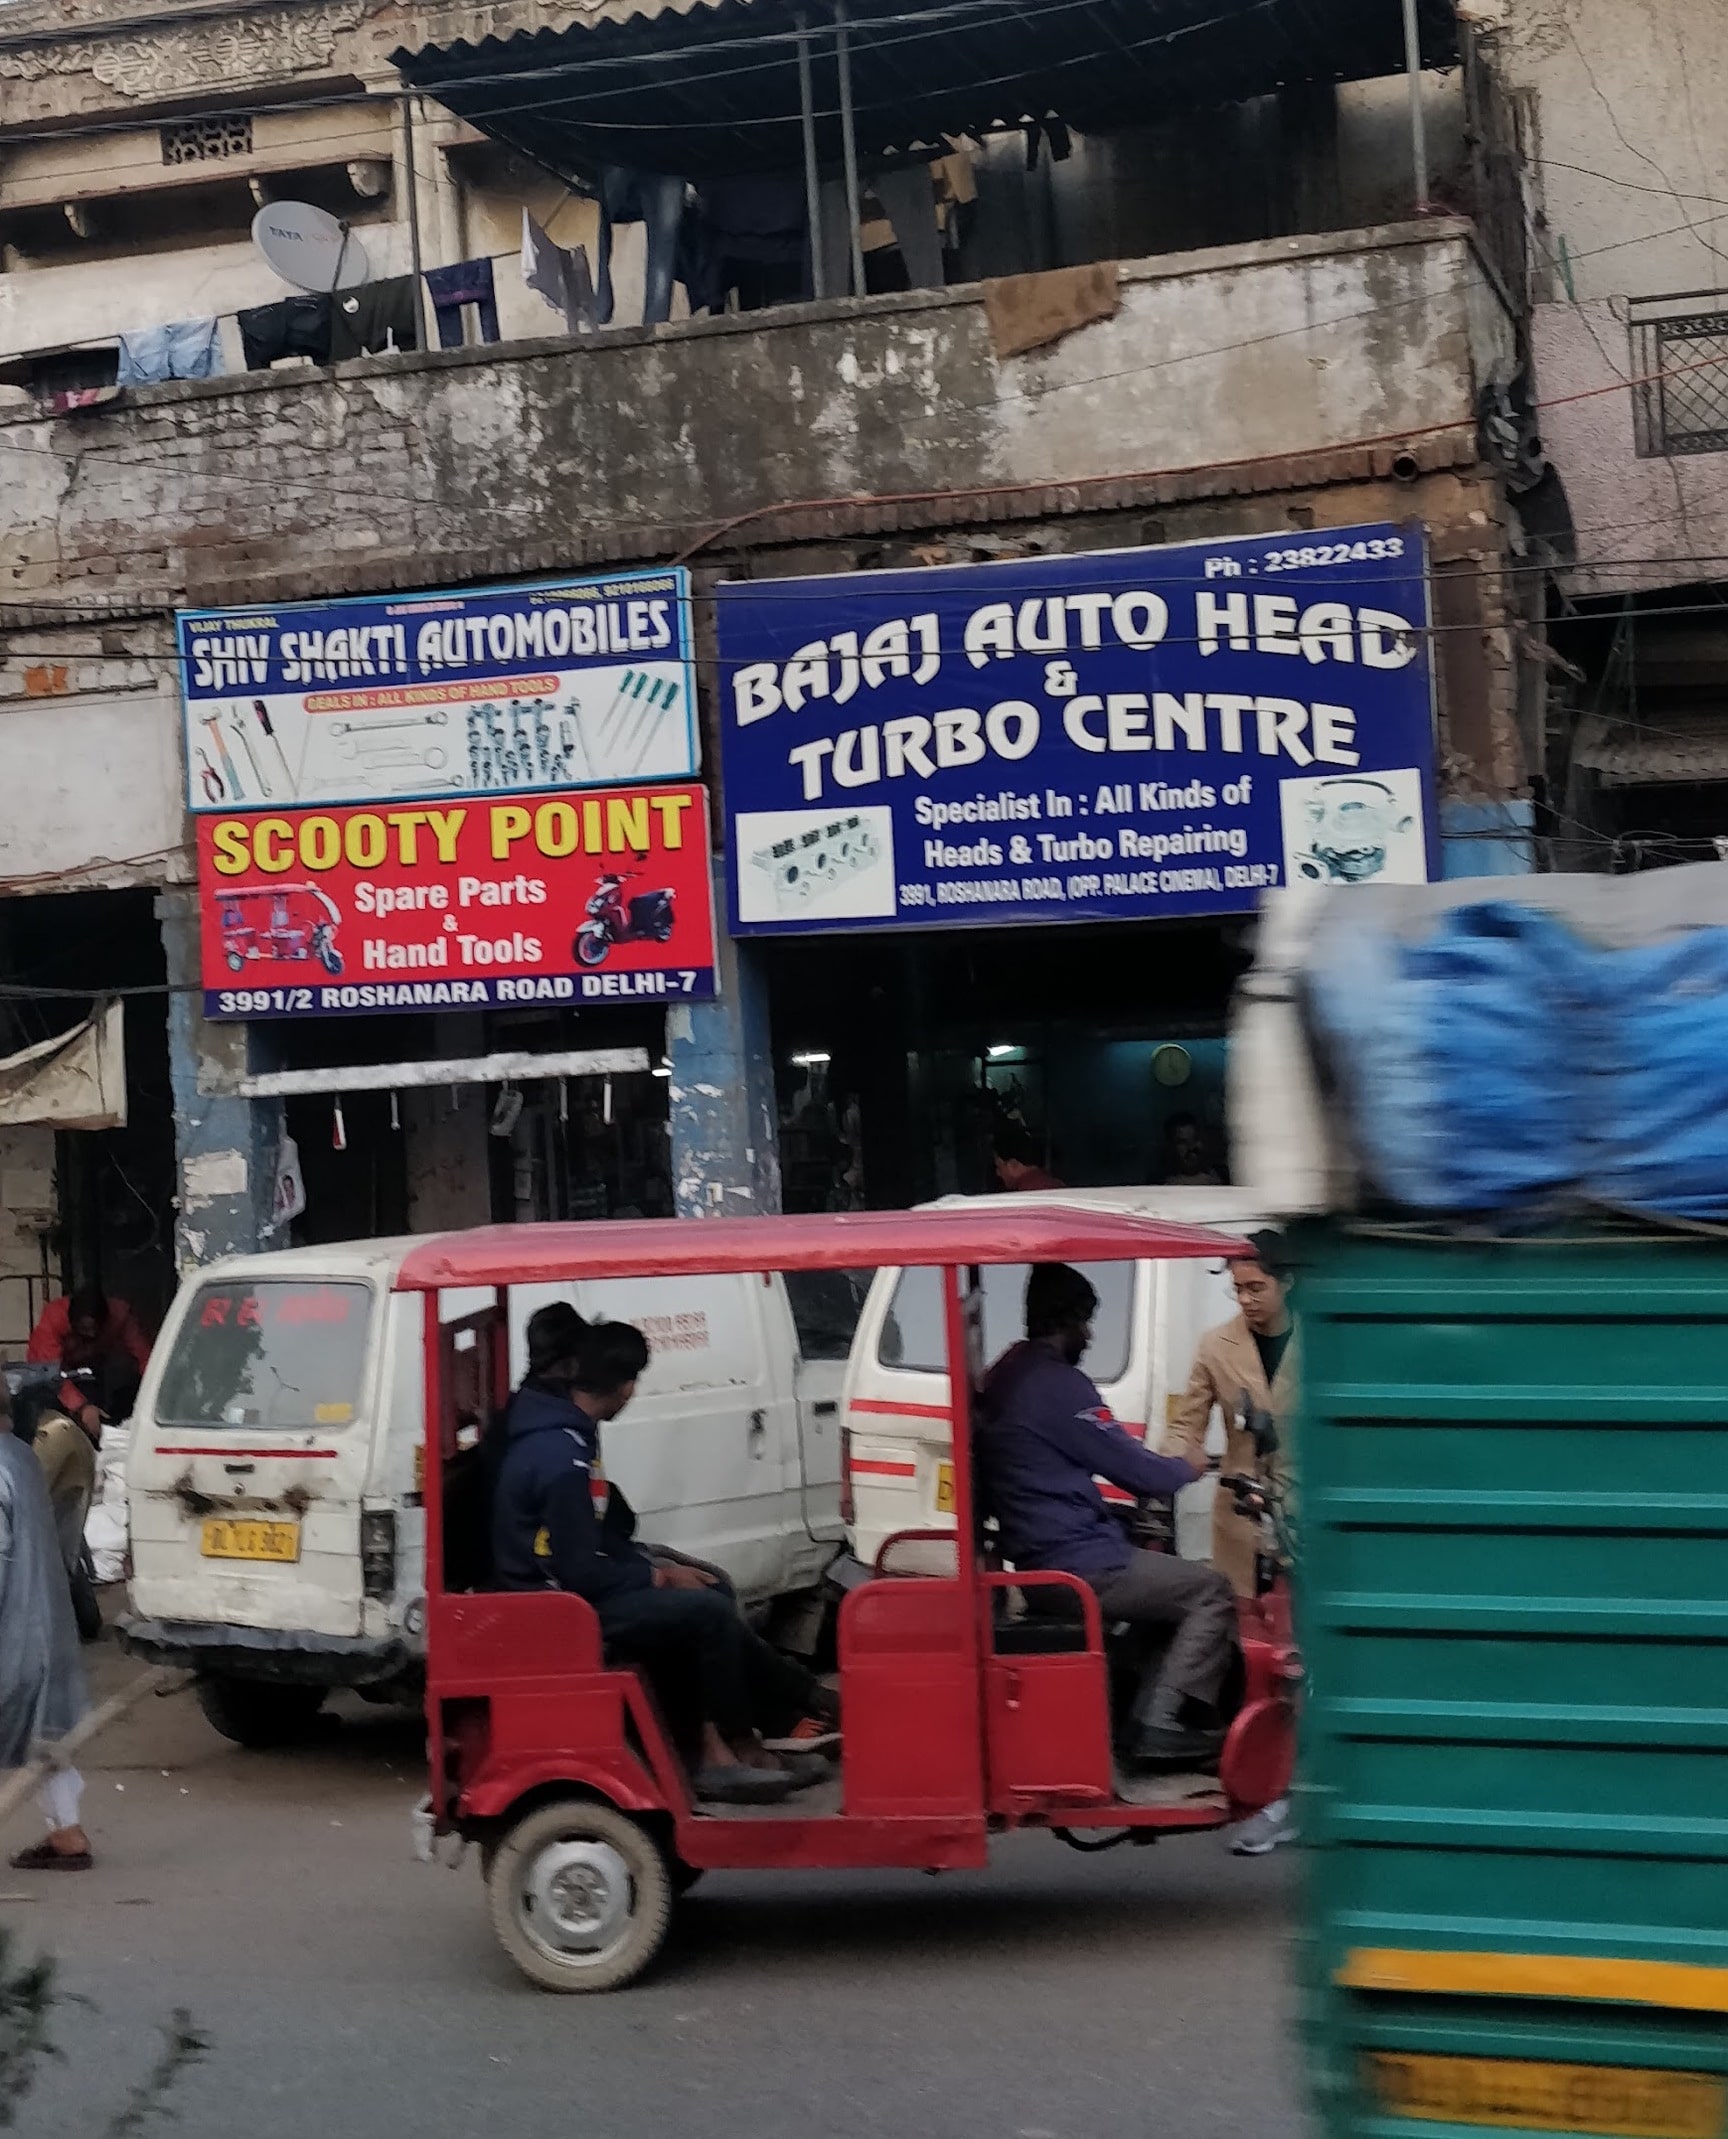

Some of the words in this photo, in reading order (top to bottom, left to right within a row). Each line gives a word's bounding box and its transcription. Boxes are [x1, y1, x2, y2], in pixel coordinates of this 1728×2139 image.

[1204, 556, 1242, 578] Ph
[1264, 537, 1404, 572] 23822433
[192, 634, 271, 692] SHIV
[279, 623, 408, 685] SHAKTI
[417, 602, 671, 676] AUTOMOBILES
[732, 612, 942, 727] BAJAJ
[963, 591, 1168, 669] AUTO
[1195, 591, 1416, 670] HEAD
[307, 695, 351, 711] DEALS
[351, 694, 368, 707] IN
[377, 691, 403, 706] ALL
[404, 687, 447, 704] KINDS
[449, 685, 468, 700] OF
[469, 682, 508, 698] HAND
[511, 678, 555, 695] TOOLS
[1042, 660, 1078, 696] &
[788, 700, 1040, 801] TURBO
[1062, 693, 1361, 767] CENTRE
[914, 791, 1042, 831] Specialist
[1045, 789, 1073, 818] In
[1094, 782, 1134, 814] All
[1139, 778, 1217, 811] Kinds
[1222, 775, 1253, 805] of
[213, 808, 468, 875] SCOOTY
[490, 794, 693, 859] POINT
[924, 837, 1003, 868] Heads
[1009, 835, 1034, 865] &
[1036, 832, 1113, 863] Turbo
[1118, 823, 1248, 863] Repairing
[354, 881, 449, 918] Spare
[458, 874, 547, 907] Parts
[1103, 870, 1160, 895] PALACE
[442, 914, 459, 932] &
[363, 935, 449, 969] Hand
[455, 932, 543, 965] Tools
[218, 988, 313, 1012] 3991/2
[321, 981, 489, 1009] ROSHANARA
[497, 976, 574, 1001] ROAD
[582, 971, 697, 997] DELHI-7
